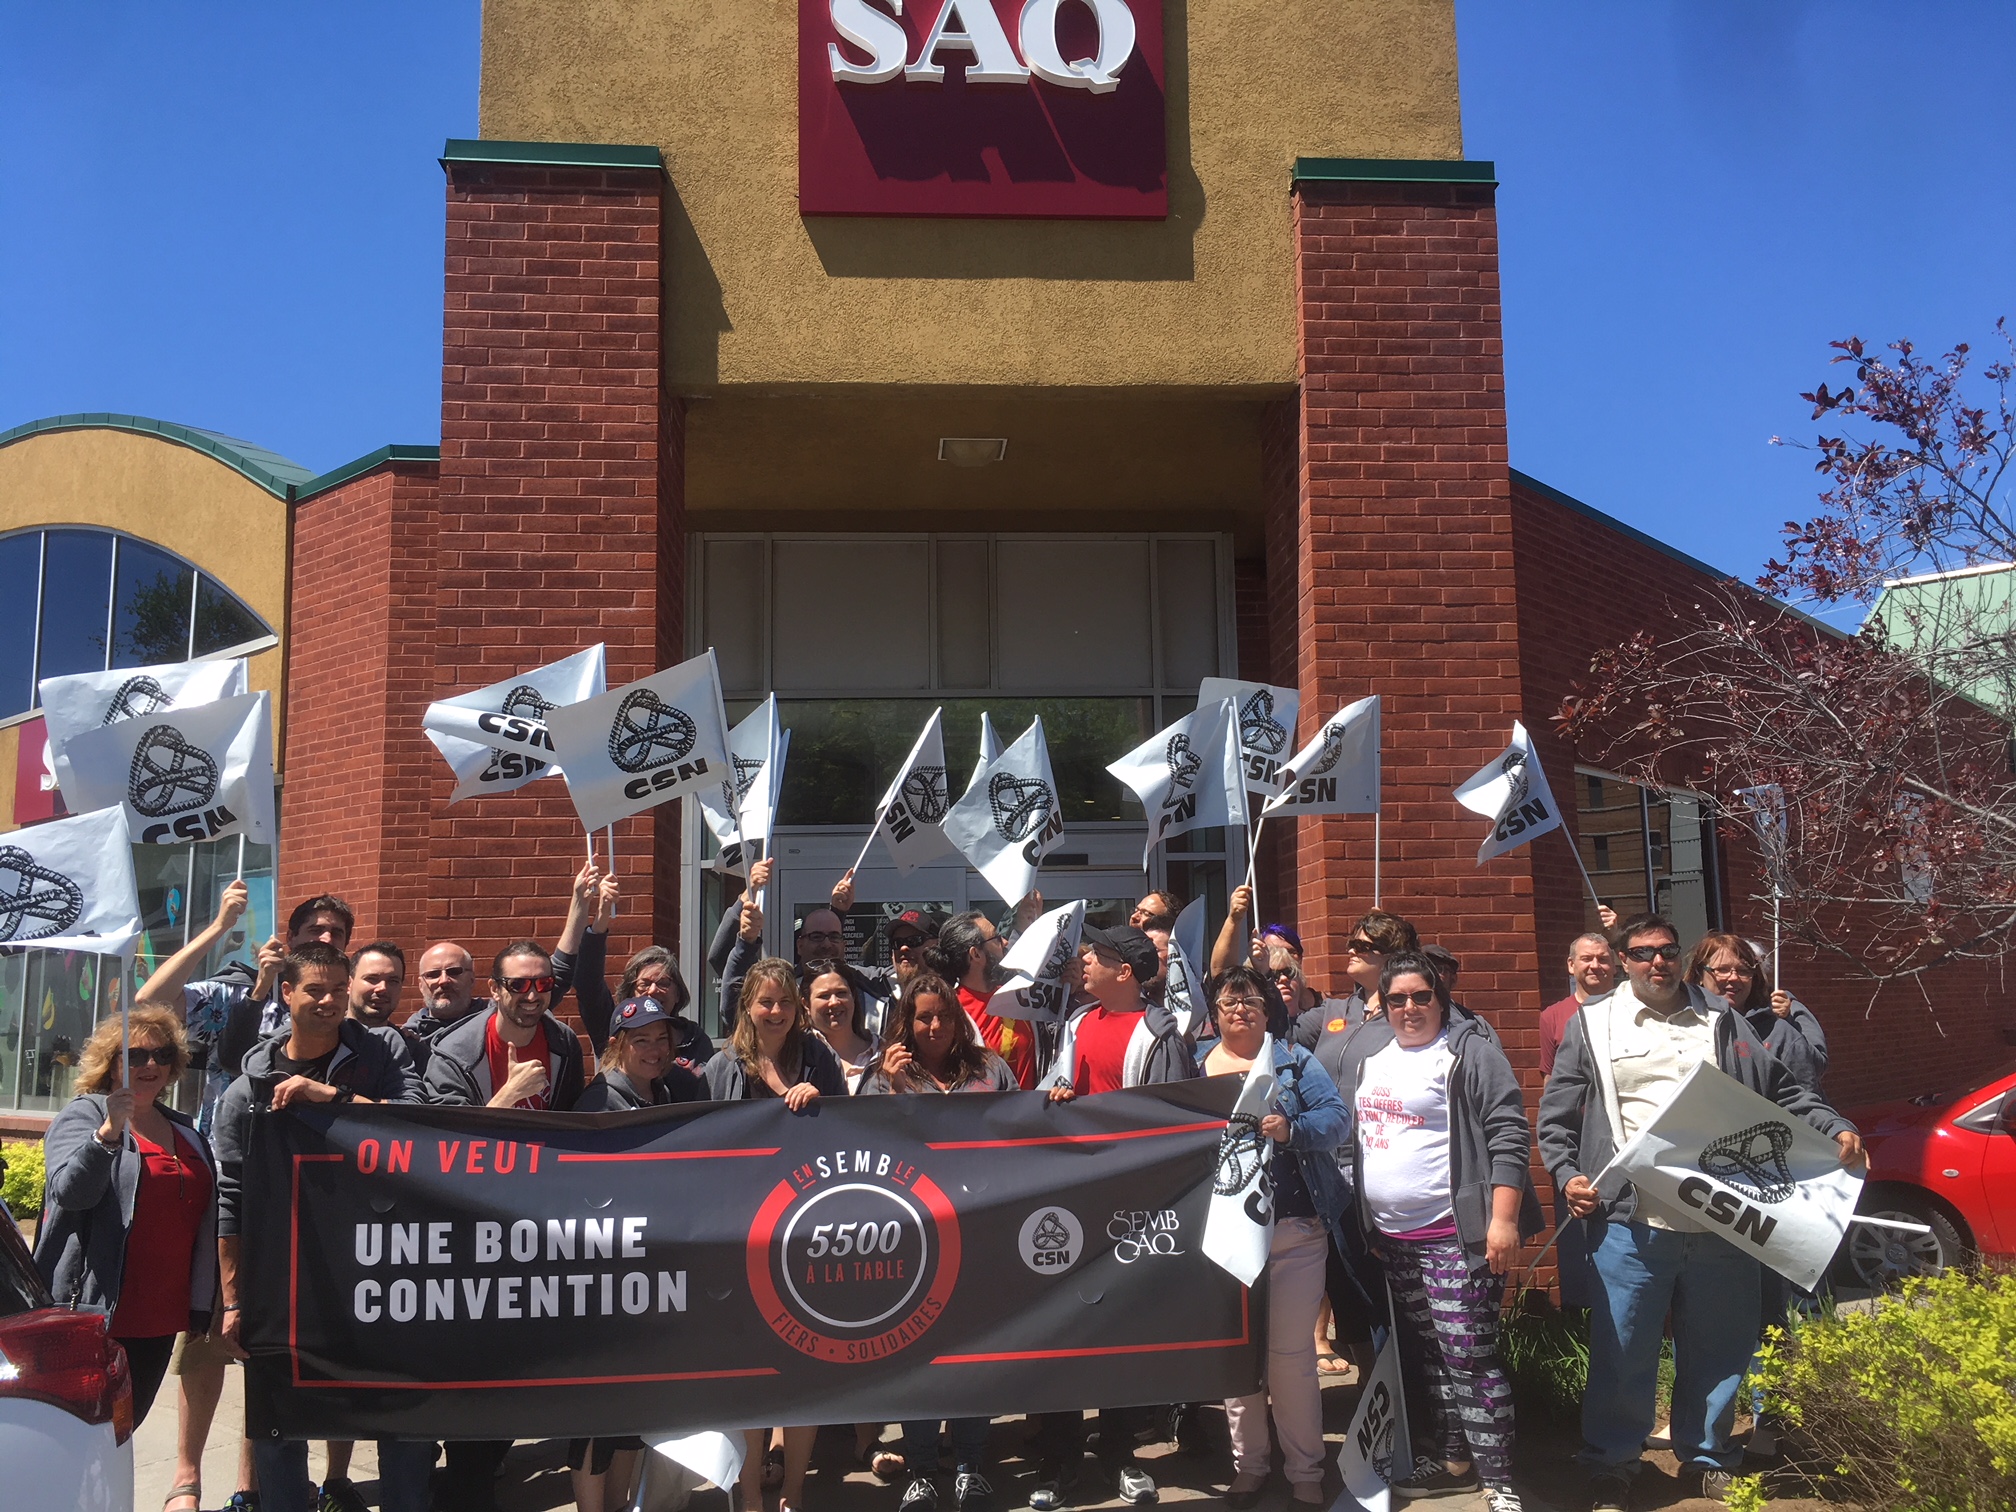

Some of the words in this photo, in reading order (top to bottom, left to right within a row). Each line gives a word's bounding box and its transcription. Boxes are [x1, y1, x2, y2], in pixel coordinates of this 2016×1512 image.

[828, 0, 1136, 94] SAQ
[624, 757, 709, 800] CSN
[884, 797, 916, 844] SN
[1495, 797, 1550, 842] CSN
[1359, 1097, 1372, 1108] TES
[1374, 1098, 1403, 1113] OFFRES
[1374, 1137, 1390, 1150] ANS
[1375, 1124, 1385, 1136] DE
[357, 1138, 413, 1174] ON
[438, 1140, 546, 1174] VEUT
[1106, 1209, 1181, 1240] SEMB
[1677, 1176, 1778, 1247] CSN
[355, 1221, 453, 1267] UNE
[475, 1216, 648, 1263] BONNE
[806, 1220, 902, 1258] 5500
[1032, 1250, 1070, 1267] CSN
[1114, 1232, 1186, 1264] SAQ
[806, 1261, 815, 1284] À
[824, 1263, 845, 1283] LA
[854, 1259, 905, 1281] TABLE
[354, 1270, 687, 1323] CONVENTION
[771, 1311, 820, 1354] FIERS
[846, 1296, 942, 1361] SOLIDAIRES
[1357, 1380, 1391, 1463] CSN
